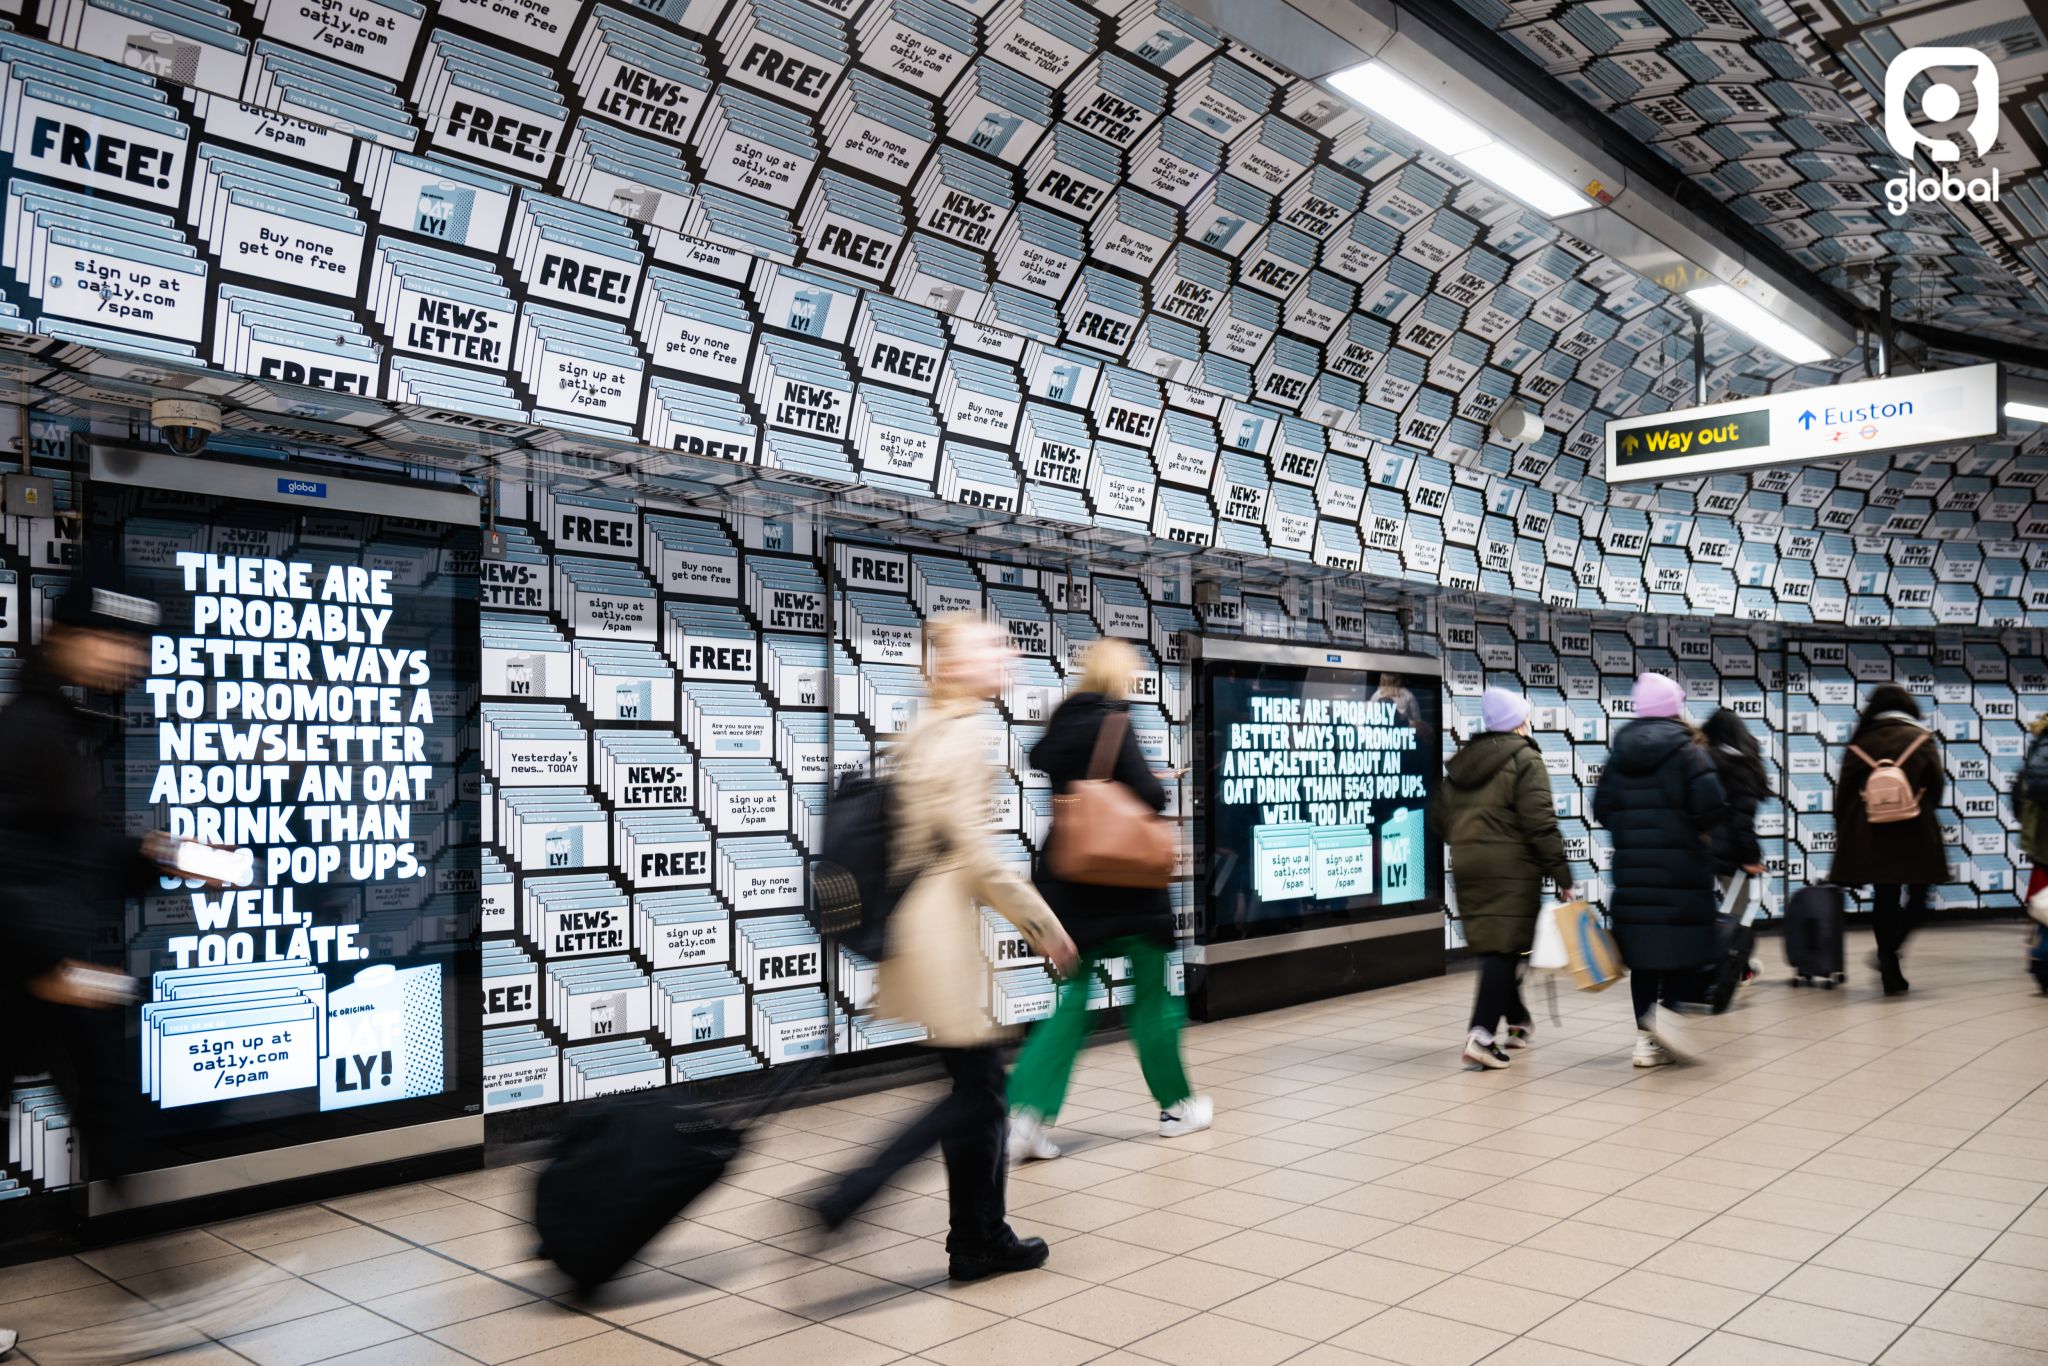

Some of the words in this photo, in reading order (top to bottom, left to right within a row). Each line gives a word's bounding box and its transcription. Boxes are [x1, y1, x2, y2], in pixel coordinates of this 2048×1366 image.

[299, 7, 388, 45] oatly.com
[313, 28, 365, 55] /spam
[1012, 32, 1070, 68] Yesterday's
[740, 42, 832, 99] FREE!
[1034, 56, 1065, 75] TODAY
[613, 65, 689, 107] NEWS-
[597, 87, 687, 137] LETTER!
[1092, 92, 1142, 123] NEWS-
[446, 101, 553, 164] FREE!
[1073, 106, 1136, 144] LETTER!
[31, 116, 174, 190] FREE!
[735, 143, 763, 165] sign
[766, 154, 780, 167] up
[782, 161, 797, 171] at
[732, 156, 789, 183] oatly.com
[737, 170, 772, 191] /spam
[1037, 170, 1104, 211] FREE!
[419, 214, 447, 236] LY!
[259, 227, 289, 248] Buy
[295, 239, 334, 257] none
[818, 225, 893, 270] FREE!
[239, 241, 269, 256] get
[275, 244, 304, 264] one
[310, 252, 346, 274] free
[74, 259, 121, 286] sign
[129, 272, 151, 288] up
[159, 278, 180, 292] at
[539, 253, 631, 305] FREE!
[1249, 259, 1300, 292] FREE!
[97, 295, 154, 320] /spam
[418, 297, 498, 333] NEWS-
[407, 322, 502, 363] LETTER!
[666, 341, 686, 353] get
[689, 343, 709, 358] one
[713, 350, 737, 365] free
[680, 330, 701, 346] Buy
[704, 338, 730, 354] none
[870, 343, 937, 383] FREE!
[784, 382, 840, 409] NEWS-
[776, 402, 841, 434] LETTER!
[1105, 406, 1155, 438] FREE!
[1825, 400, 1913, 426] Euston
[1646, 428, 1695, 453] Way
[1698, 422, 1739, 445] out
[1041, 442, 1082, 463] NEWS-
[1280, 452, 1318, 478] FREE!
[1034, 459, 1082, 485] LETTER!
[288, 481, 317, 494] global
[1230, 484, 1261, 504] NEWS-
[1225, 502, 1260, 522] LETTER!
[1523, 513, 1548, 534] FREE!
[562, 515, 633, 547] FREE!
[1610, 532, 1642, 550] FREE!
[176, 551, 312, 600] THERE
[321, 565, 393, 608] ARE
[1783, 583, 1810, 596] FREE!
[589, 597, 614, 613] sign
[617, 602, 629, 612] up
[591, 608, 643, 624] oatly.com
[194, 596, 394, 645] PROBABLY
[602, 619, 632, 632] /spam
[1448, 628, 1474, 643] FREE!
[1561, 636, 1589, 650] FREE!
[151, 635, 313, 681] BETTER
[321, 645, 430, 686] WAYS
[690, 645, 752, 671] FREE!
[511, 681, 530, 694] LY!
[146, 679, 204, 719] TO
[216, 681, 401, 723] PROMOTE
[408, 688, 434, 724] A
[1251, 697, 1300, 723] THERE
[1303, 699, 1330, 724] ARE
[1333, 701, 1396, 726] PROBABLY
[1733, 701, 1762, 713] FREE!
[1985, 703, 2014, 714] FREE!
[159, 722, 427, 762] NEWSLETTER
[1231, 723, 1290, 750] BETTER
[1293, 726, 1334, 750] WAYS
[1336, 726, 1355, 750] TO
[1358, 727, 1416, 750] PROMOTE
[511, 751, 578, 766] Yesterday's
[547, 762, 578, 773] TODAY
[1224, 753, 1235, 776] A
[1238, 752, 1336, 776] NEWSLETTER
[1338, 752, 1381, 775] ABOUT
[1383, 752, 1400, 774] AN
[149, 764, 290, 805] ABOUT
[297, 765, 353, 802] AN
[362, 765, 433, 802] OAT
[628, 766, 683, 784] NEWS-
[624, 785, 687, 804] LETTER!
[729, 794, 751, 806] sign
[1224, 779, 1253, 804] OAT
[1257, 778, 1301, 804] DRINK
[1303, 778, 1342, 801] THAN
[1345, 778, 1374, 800] 5543
[1376, 777, 1399, 799] POP
[1401, 775, 1426, 798] UPS.
[731, 803, 776, 817] oatly.com
[741, 814, 766, 825] /spam
[1309, 803, 1337, 825] TOO
[1340, 801, 1375, 824] LATE.
[170, 806, 297, 845] DRINK
[304, 804, 410, 843] THAN
[267, 845, 341, 886] POP
[349, 842, 427, 881] UPS.
[641, 852, 706, 878] FREE!
[1272, 855, 1290, 865] sign
[1326, 854, 1343, 866] sign
[1327, 866, 1362, 877] oatly.com
[1282, 879, 1304, 890] /spam
[1335, 877, 1355, 888] /spam
[1387, 865, 1407, 888] LY!
[191, 887, 313, 931] WELL,
[560, 911, 618, 931] NEWS-
[168, 933, 254, 969] TOO
[265, 924, 369, 963] LATE.
[555, 930, 623, 952] LETTER!
[759, 952, 817, 980] FREE!
[328, 1009, 337, 1018] HE
[340, 1004, 375, 1016] ORIGINAL
[189, 1039, 234, 1055] sign
[242, 1037, 264, 1050] up
[271, 1030, 292, 1044] at
[193, 1051, 289, 1072] oatly.com
[335, 1051, 393, 1093] LY!
[214, 1070, 269, 1089] /spam
